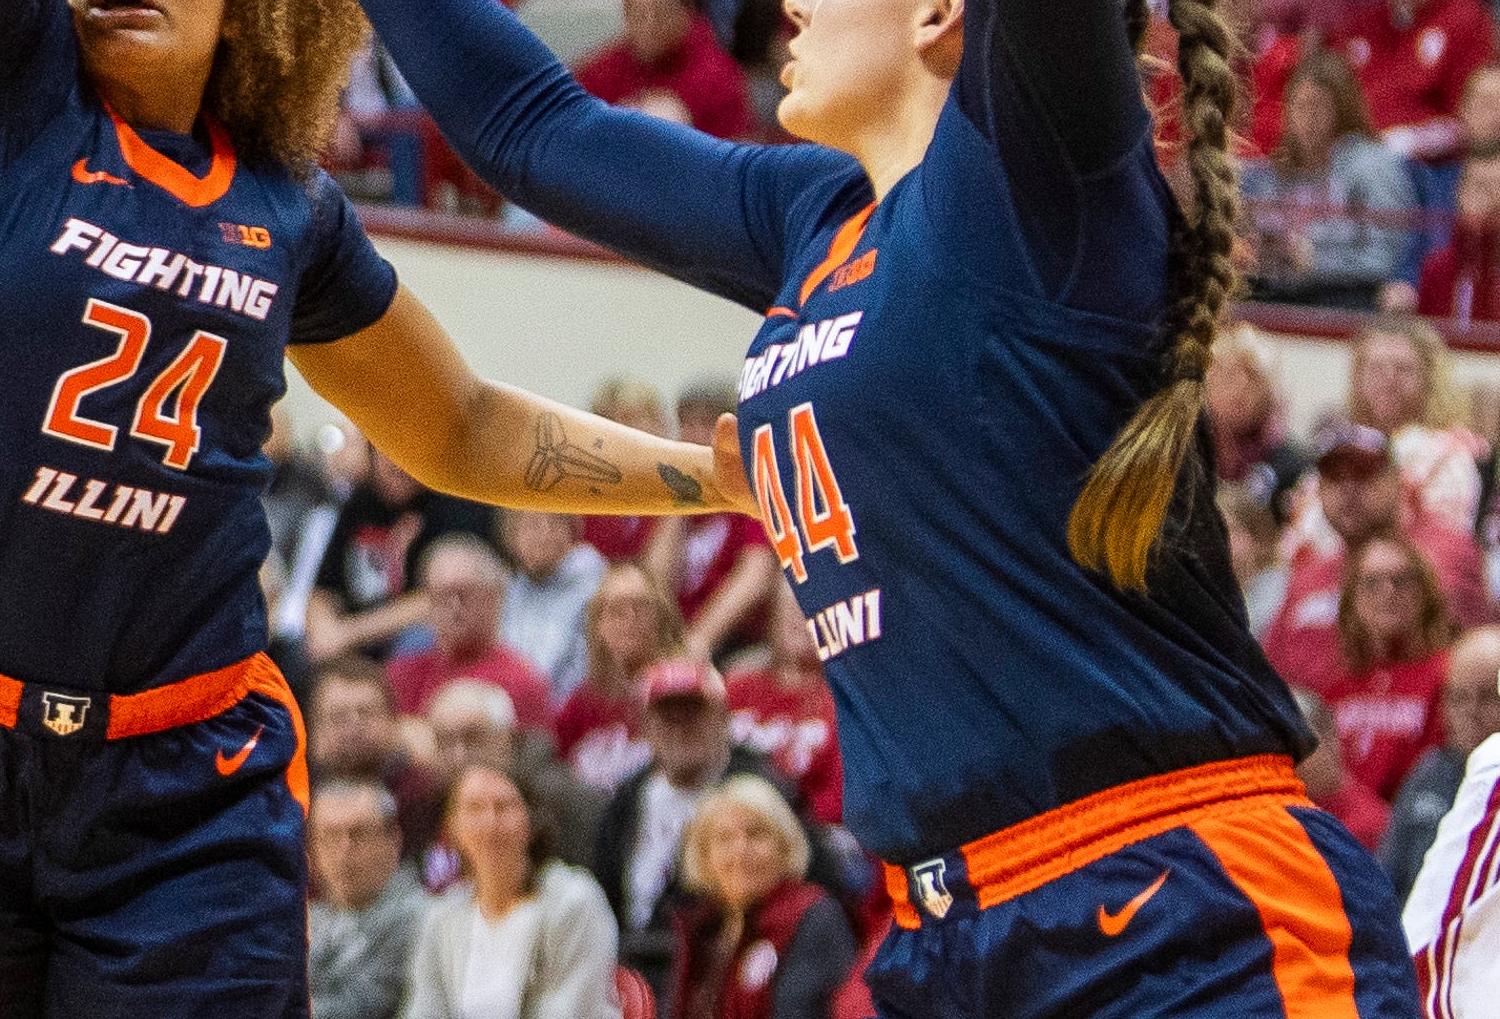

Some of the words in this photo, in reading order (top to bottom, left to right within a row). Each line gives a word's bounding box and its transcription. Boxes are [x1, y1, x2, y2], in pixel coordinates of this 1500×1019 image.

[50, 218, 279, 321] FIGHTING
[42, 297, 228, 470] 24
[737, 310, 863, 403] IGHTING
[22, 466, 187, 533] ILLINI
[752, 401, 860, 584] 44
